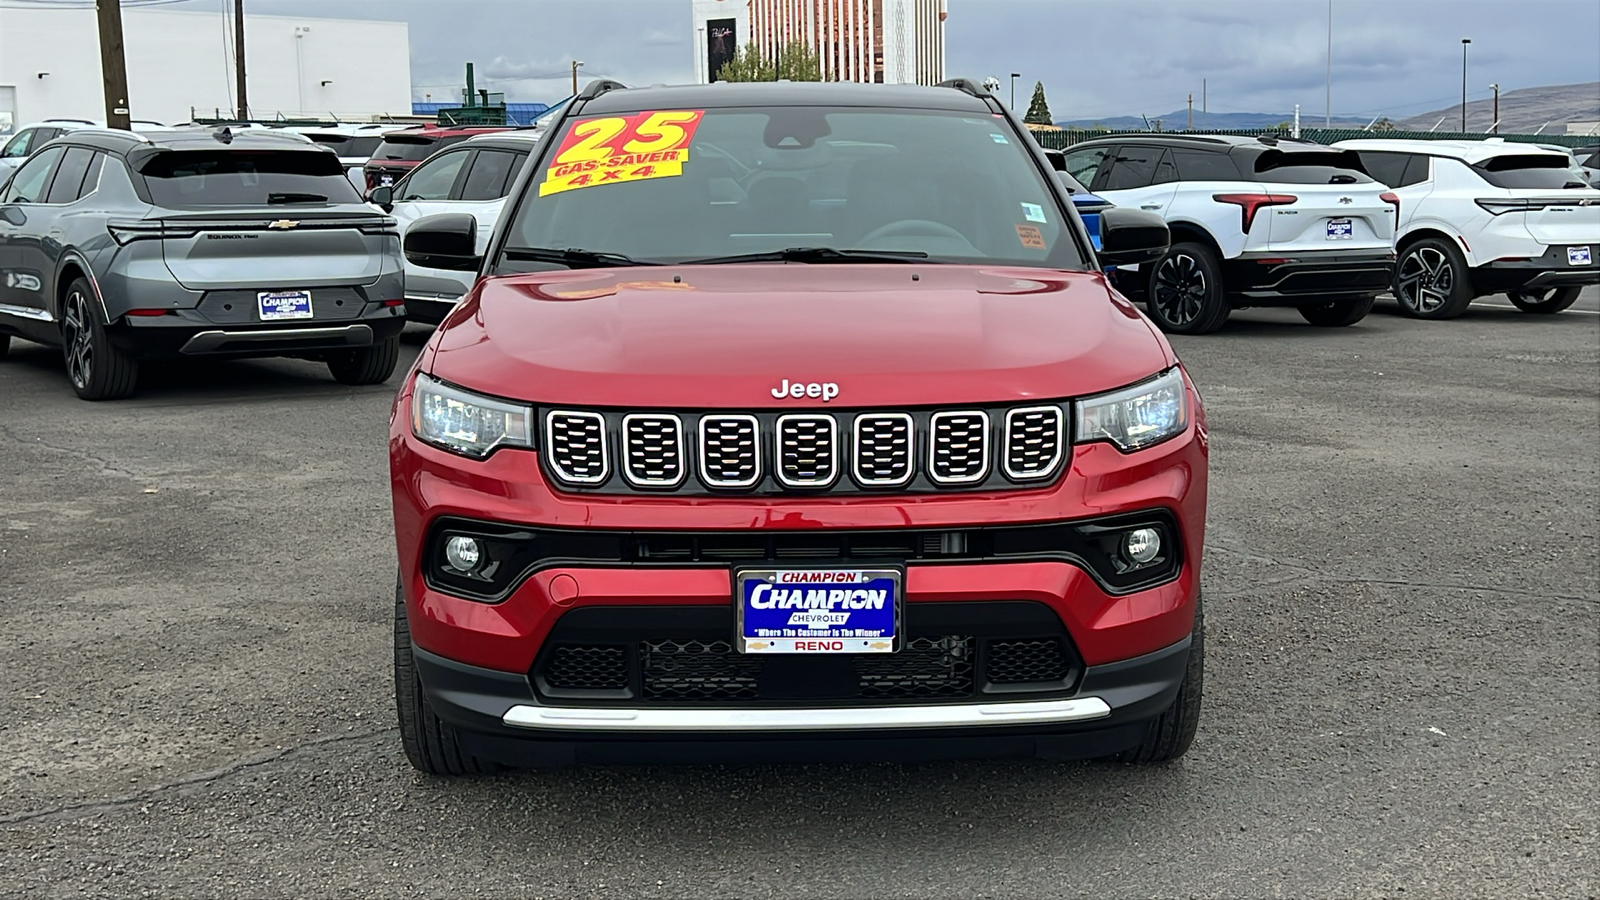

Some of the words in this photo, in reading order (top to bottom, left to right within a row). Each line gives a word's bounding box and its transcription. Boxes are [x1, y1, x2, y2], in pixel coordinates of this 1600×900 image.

[556, 111, 698, 163] 25
[555, 150, 680, 177] GAS-SAVER
[263, 297, 307, 307] CHAMPION
[771, 379, 839, 402] Jeep
[781, 572, 857, 583] CHAMPION
[750, 583, 887, 610] CHAMPION
[792, 614, 845, 623] CHEVROLET
[782, 629, 796, 637] The
[797, 629, 831, 637] Customer
[841, 629, 854, 637] The
[794, 641, 844, 651] RENO
